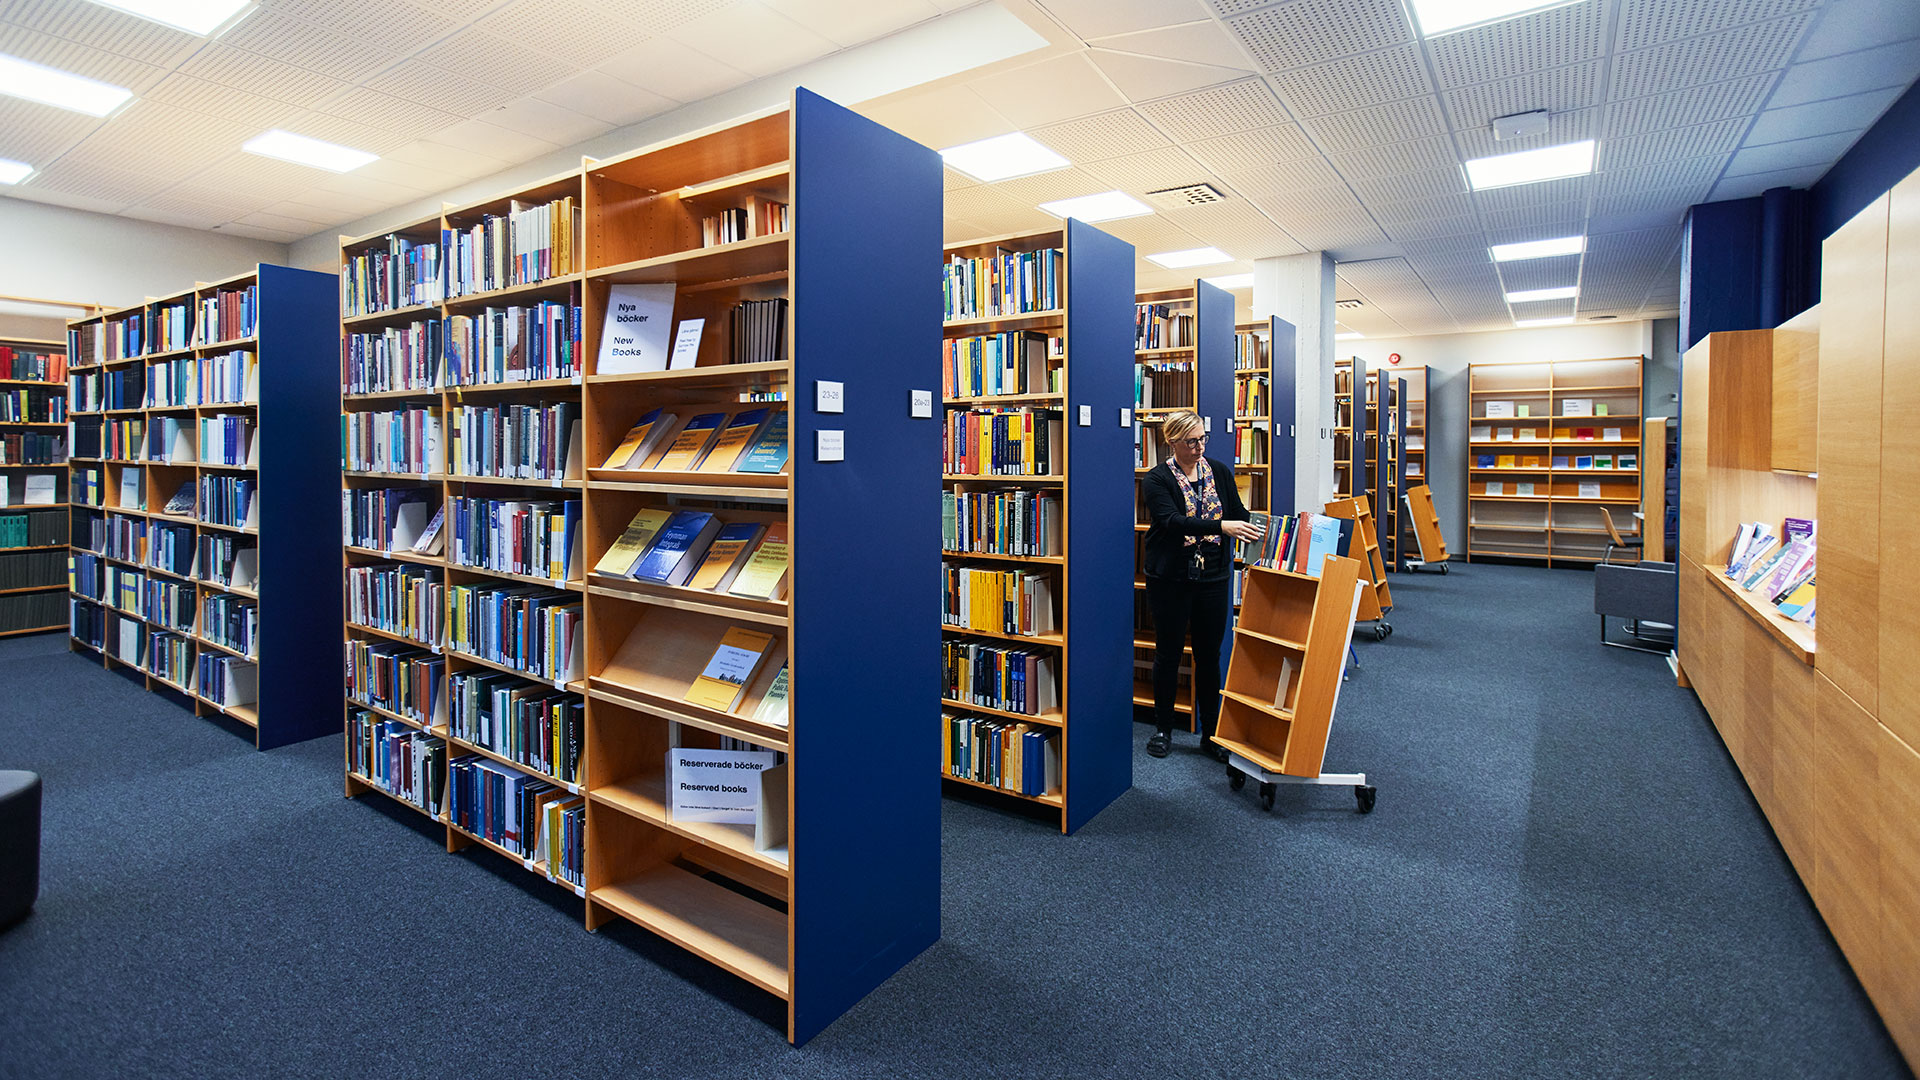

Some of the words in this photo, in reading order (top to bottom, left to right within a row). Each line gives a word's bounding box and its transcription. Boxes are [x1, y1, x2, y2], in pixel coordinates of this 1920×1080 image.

[618, 303, 636, 313] Nya
[616, 314, 649, 323] böcker
[613, 336, 634, 344] New
[611, 348, 642, 356] Books
[680, 758, 732, 769] Reserverade
[734, 761, 764, 771] böcker
[680, 782, 719, 792] Reserved
[721, 784, 748, 794] books
